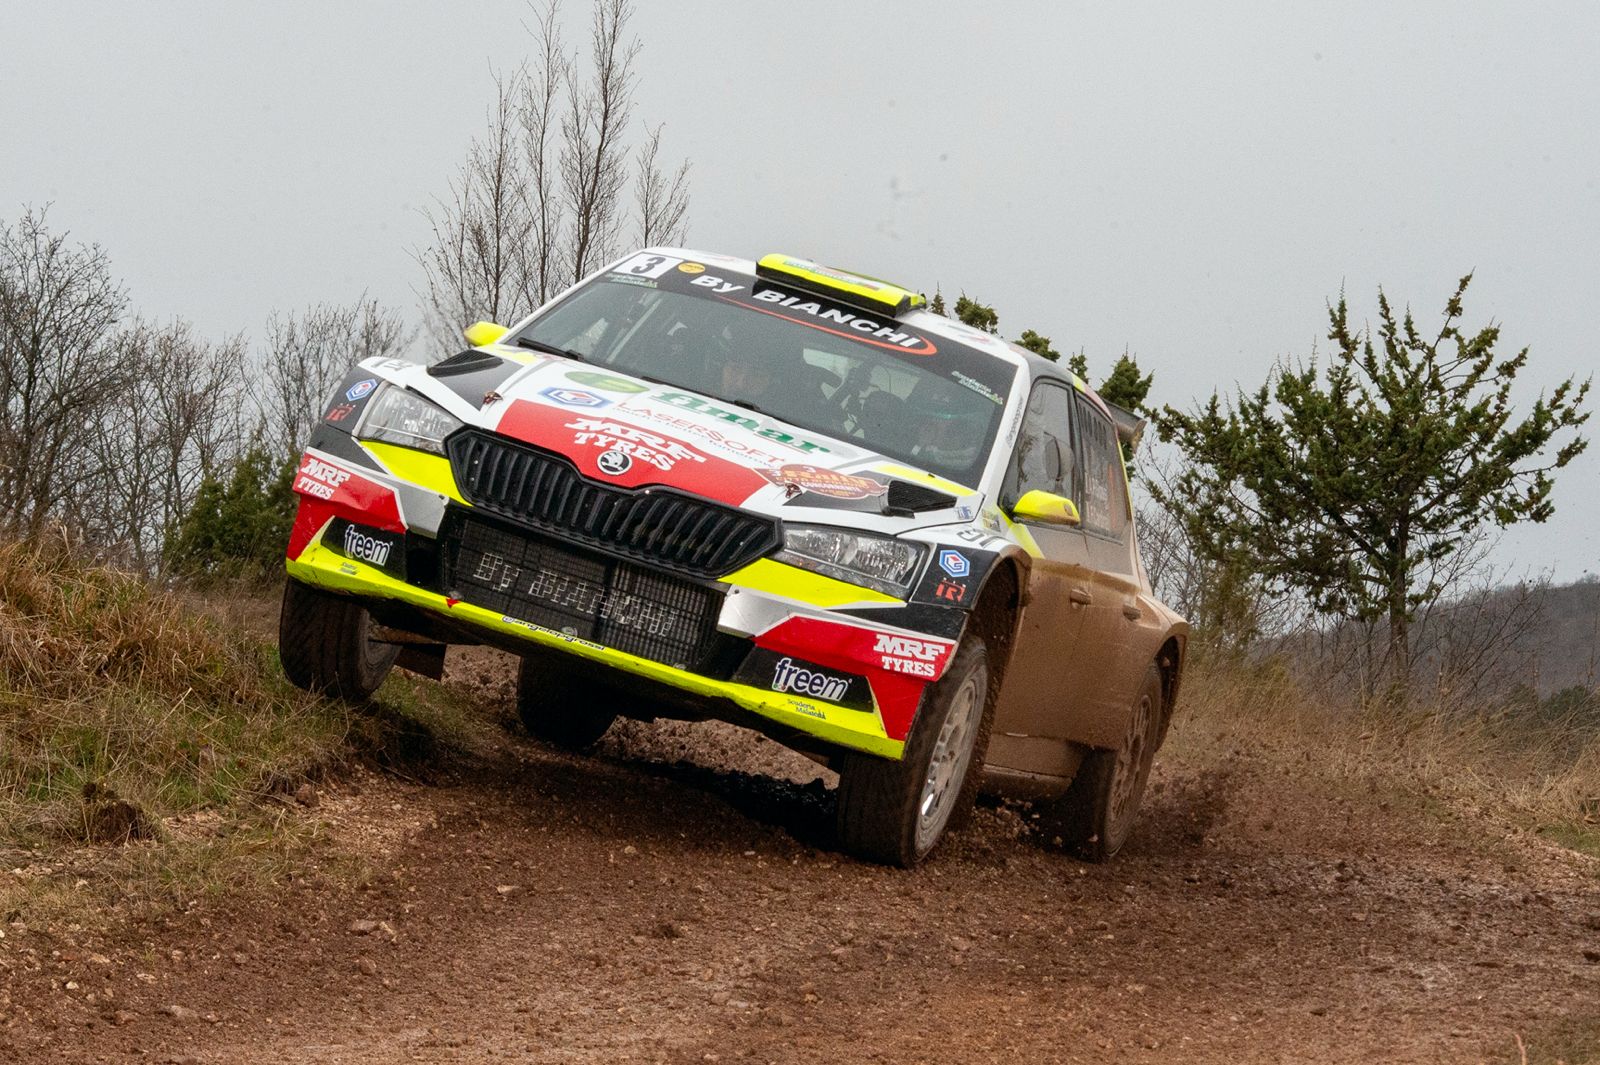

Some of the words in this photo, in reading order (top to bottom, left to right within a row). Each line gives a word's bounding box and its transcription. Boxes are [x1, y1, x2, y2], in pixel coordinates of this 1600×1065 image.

[630, 256, 666, 274] 3
[689, 274, 745, 294] By
[752, 289, 921, 349] BIANCHI
[564, 417, 708, 464] MRF
[574, 431, 676, 471] TYRES
[616, 402, 785, 464] LASERSOFT
[297, 476, 335, 499] TYRES
[301, 457, 351, 487] MRF
[344, 523, 390, 567] freem
[873, 633, 946, 661] MRF
[882, 656, 936, 677] TYRES
[771, 657, 849, 701] freem
